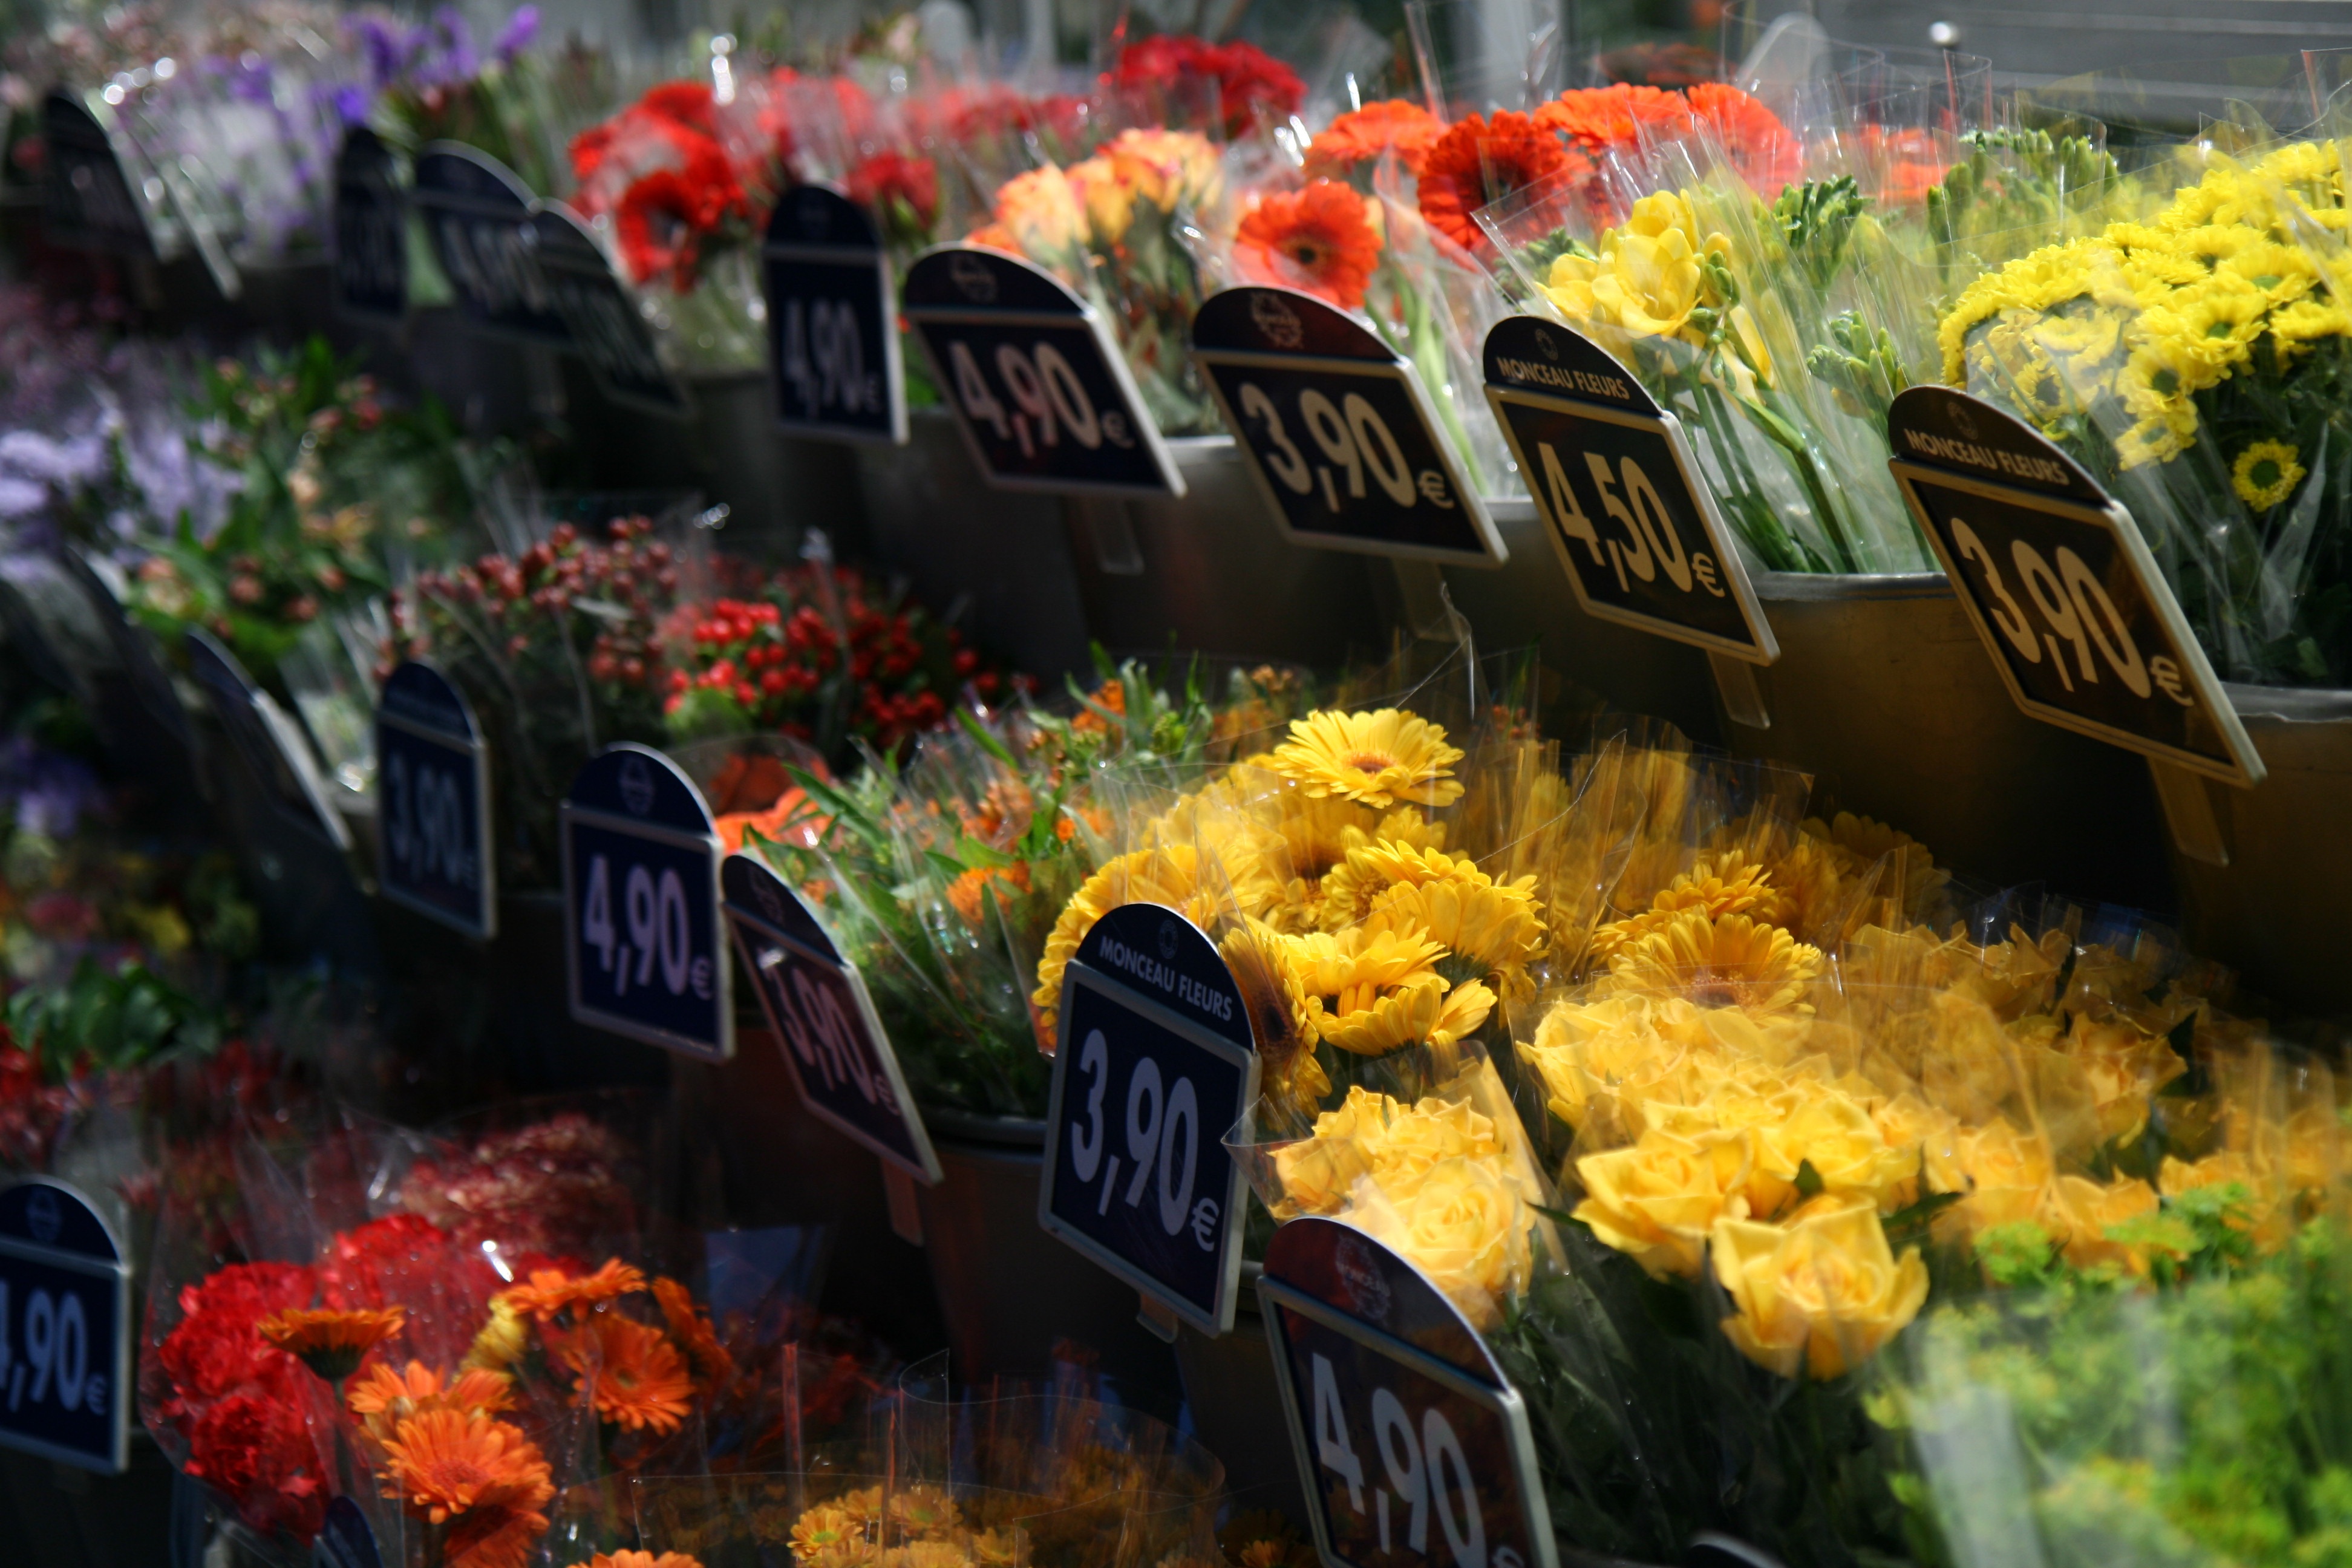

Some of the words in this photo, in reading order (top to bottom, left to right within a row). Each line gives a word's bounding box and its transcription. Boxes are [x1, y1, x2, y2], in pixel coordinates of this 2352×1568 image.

[945, 340, 1135, 459] 4,90€
[1496, 356, 1574, 390] MONCEAU
[1573, 370, 1630, 400] FLEURS
[1239, 382, 1454, 513] 3,90€
[1903, 428, 1998, 469] MONCEAU
[1996, 449, 2069, 485] FLEURS
[1538, 442, 1725, 598] 4,50€
[1950, 518, 2195, 706] 3,90€
[583, 854, 714, 1000] 4,90€
[1099, 935, 1175, 993] MONCEAU
[1178, 973, 1232, 1022] FLEURS
[1071, 1028, 1220, 1252] 3,90€
